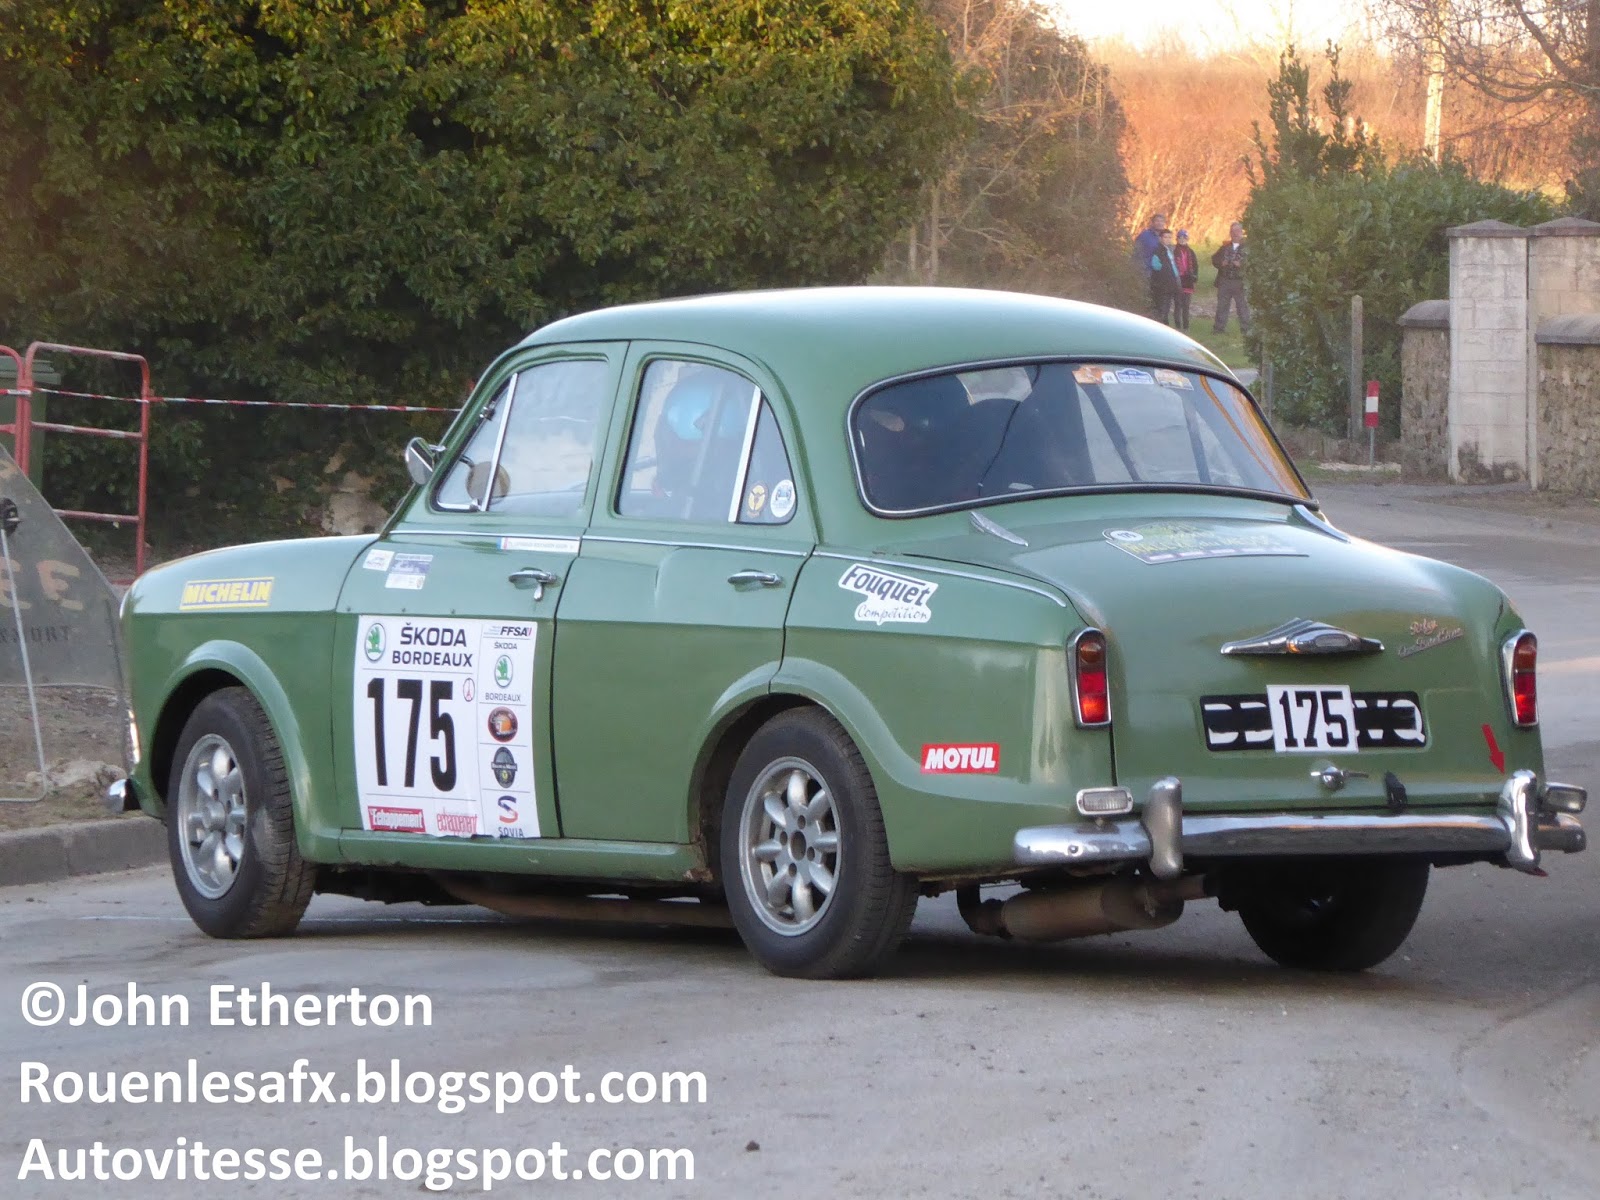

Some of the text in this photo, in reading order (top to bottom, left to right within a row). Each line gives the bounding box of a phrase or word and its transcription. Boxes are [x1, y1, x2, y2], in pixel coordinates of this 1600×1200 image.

[182, 581, 271, 604] MICHELIN
[841, 565, 931, 607] Fouquet
[399, 622, 467, 647] ŠKODA
[500, 626, 528, 637] FFSA
[392, 650, 473, 668] BORDEAUX
[485, 692, 521, 702] BORDEAUX
[1279, 690, 1350, 748] 175
[367, 677, 457, 792] 175
[924, 747, 996, 769] MOTUL
[497, 827, 524, 838] SOVIA
